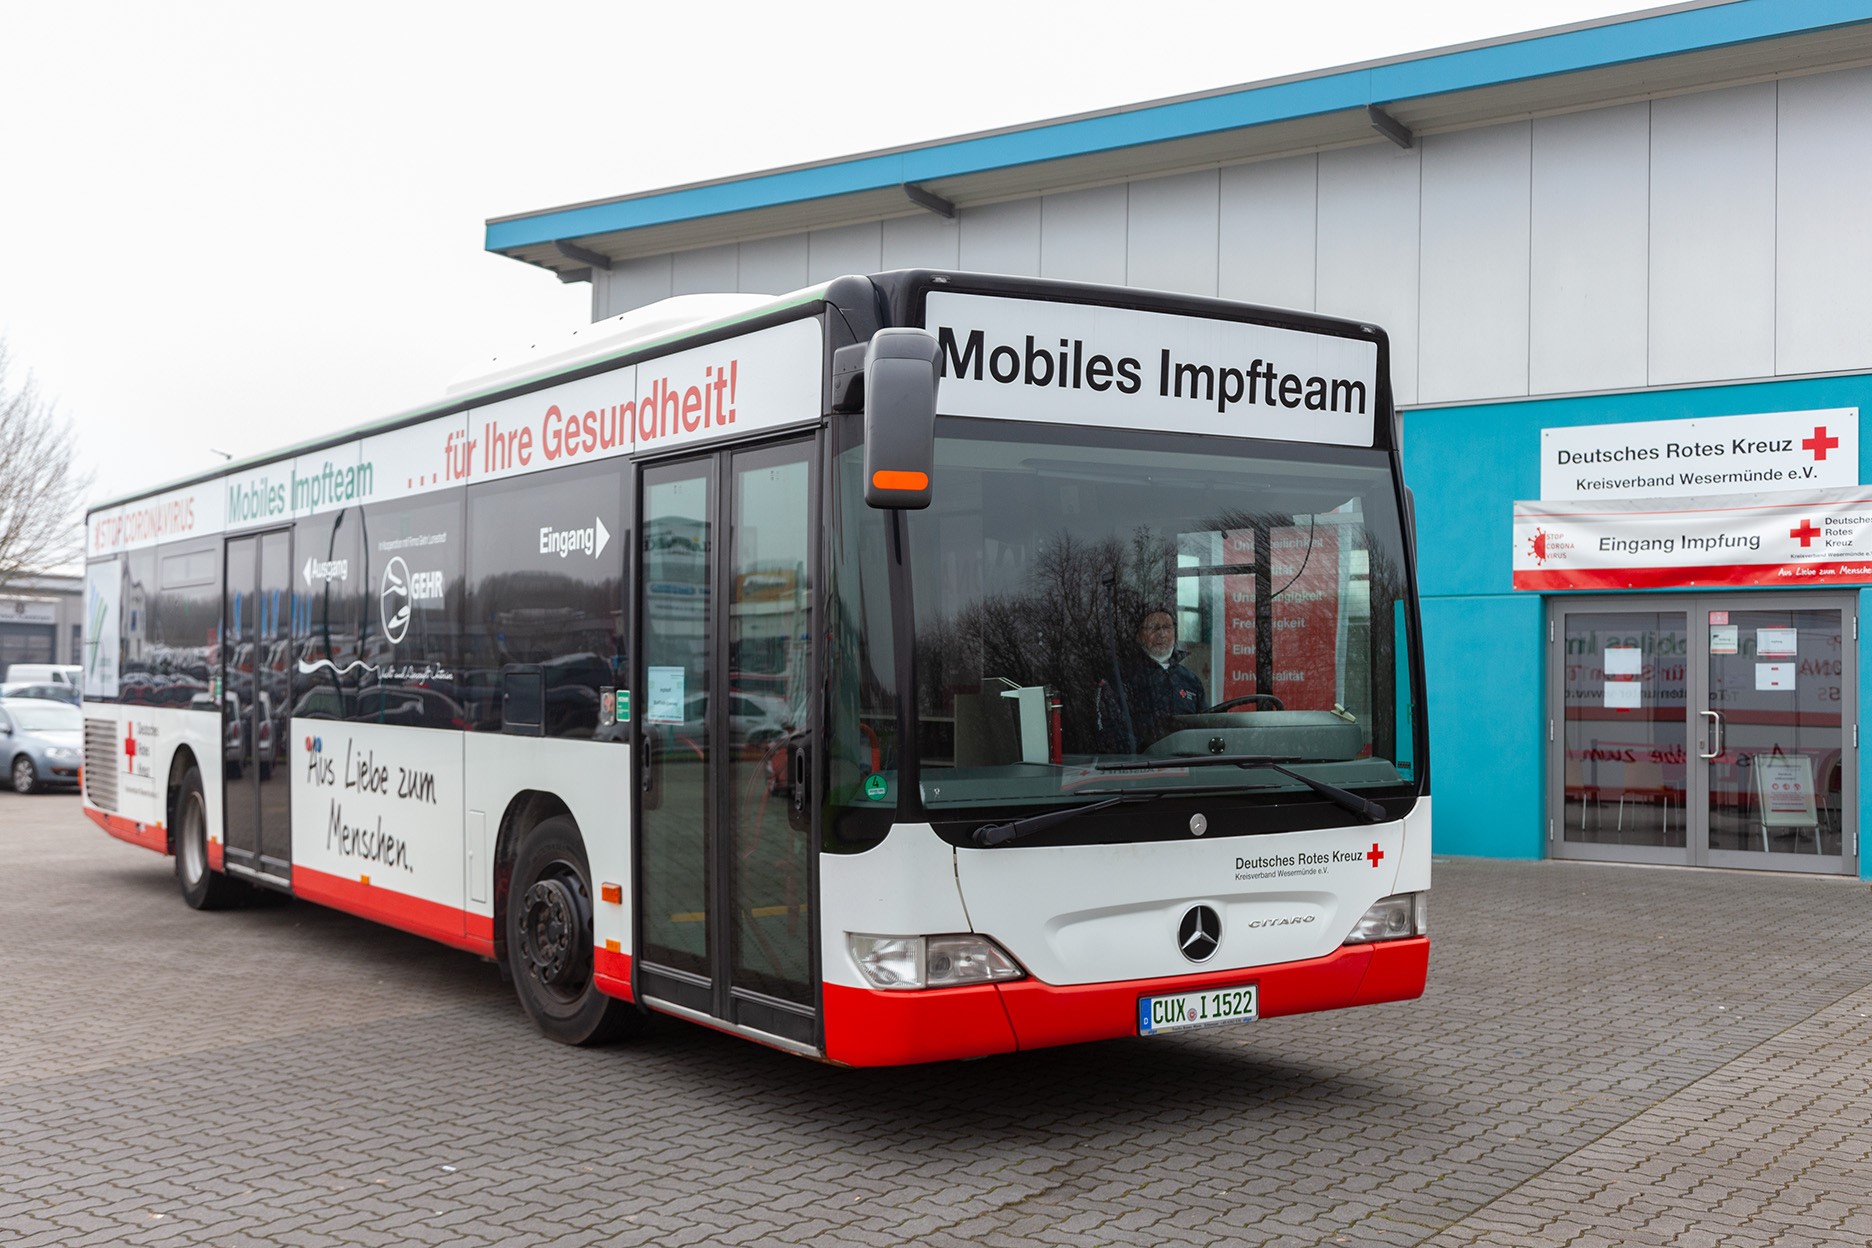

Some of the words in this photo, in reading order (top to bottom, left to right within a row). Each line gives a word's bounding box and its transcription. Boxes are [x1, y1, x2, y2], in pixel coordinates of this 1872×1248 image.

[938, 326, 1142, 395] Mobiles
[1159, 348, 1367, 414] Impfteam
[445, 429, 477, 482] für
[484, 421, 534, 474] Ihre
[541, 359, 738, 461] Gesundheit!
[1557, 445, 1660, 466] Deutsches
[1666, 440, 1725, 459] Rotes
[1731, 437, 1793, 455] Kreuz
[1576, 474, 1675, 491] Kreisverband
[1678, 468, 1783, 486] Wesermünde
[1787, 466, 1818, 480] e.V.
[228, 480, 285, 524] Mobiles
[290, 460, 374, 512] Impfteam
[539, 525, 595, 558] Eingang
[1599, 536, 1675, 554] Eingang
[1681, 533, 1761, 551] Impfung
[1825, 528, 1854, 536] Rotes
[1825, 539, 1853, 547] Kreuz
[312, 558, 348, 582] Ausgang
[1778, 568, 1792, 577] Aus
[1796, 567, 1817, 576] Liebe
[411, 571, 443, 600] GEHR
[1232, 617, 1306, 631] Freiigkeit
[1232, 670, 1305, 681] Univsalität
[307, 736, 335, 787] Aus
[345, 737, 389, 795] Liebe
[398, 766, 437, 805] zum
[872, 776, 879, 788] 4
[327, 798, 414, 874] Menschen.
[1235, 854, 1295, 870] Deutsches
[1298, 852, 1330, 865] Rotes
[1332, 850, 1363, 863] Kreuz
[1235, 870, 1276, 881] Kreisverband
[1277, 867, 1317, 878] Wesermünde
[1318, 866, 1329, 875] e.V.
[1248, 915, 1316, 928] CITARO
[1143, 1017, 1149, 1025] D
[1152, 997, 1186, 1024] CUX
[1199, 995, 1209, 1018] I
[1212, 990, 1253, 1016] 1522
